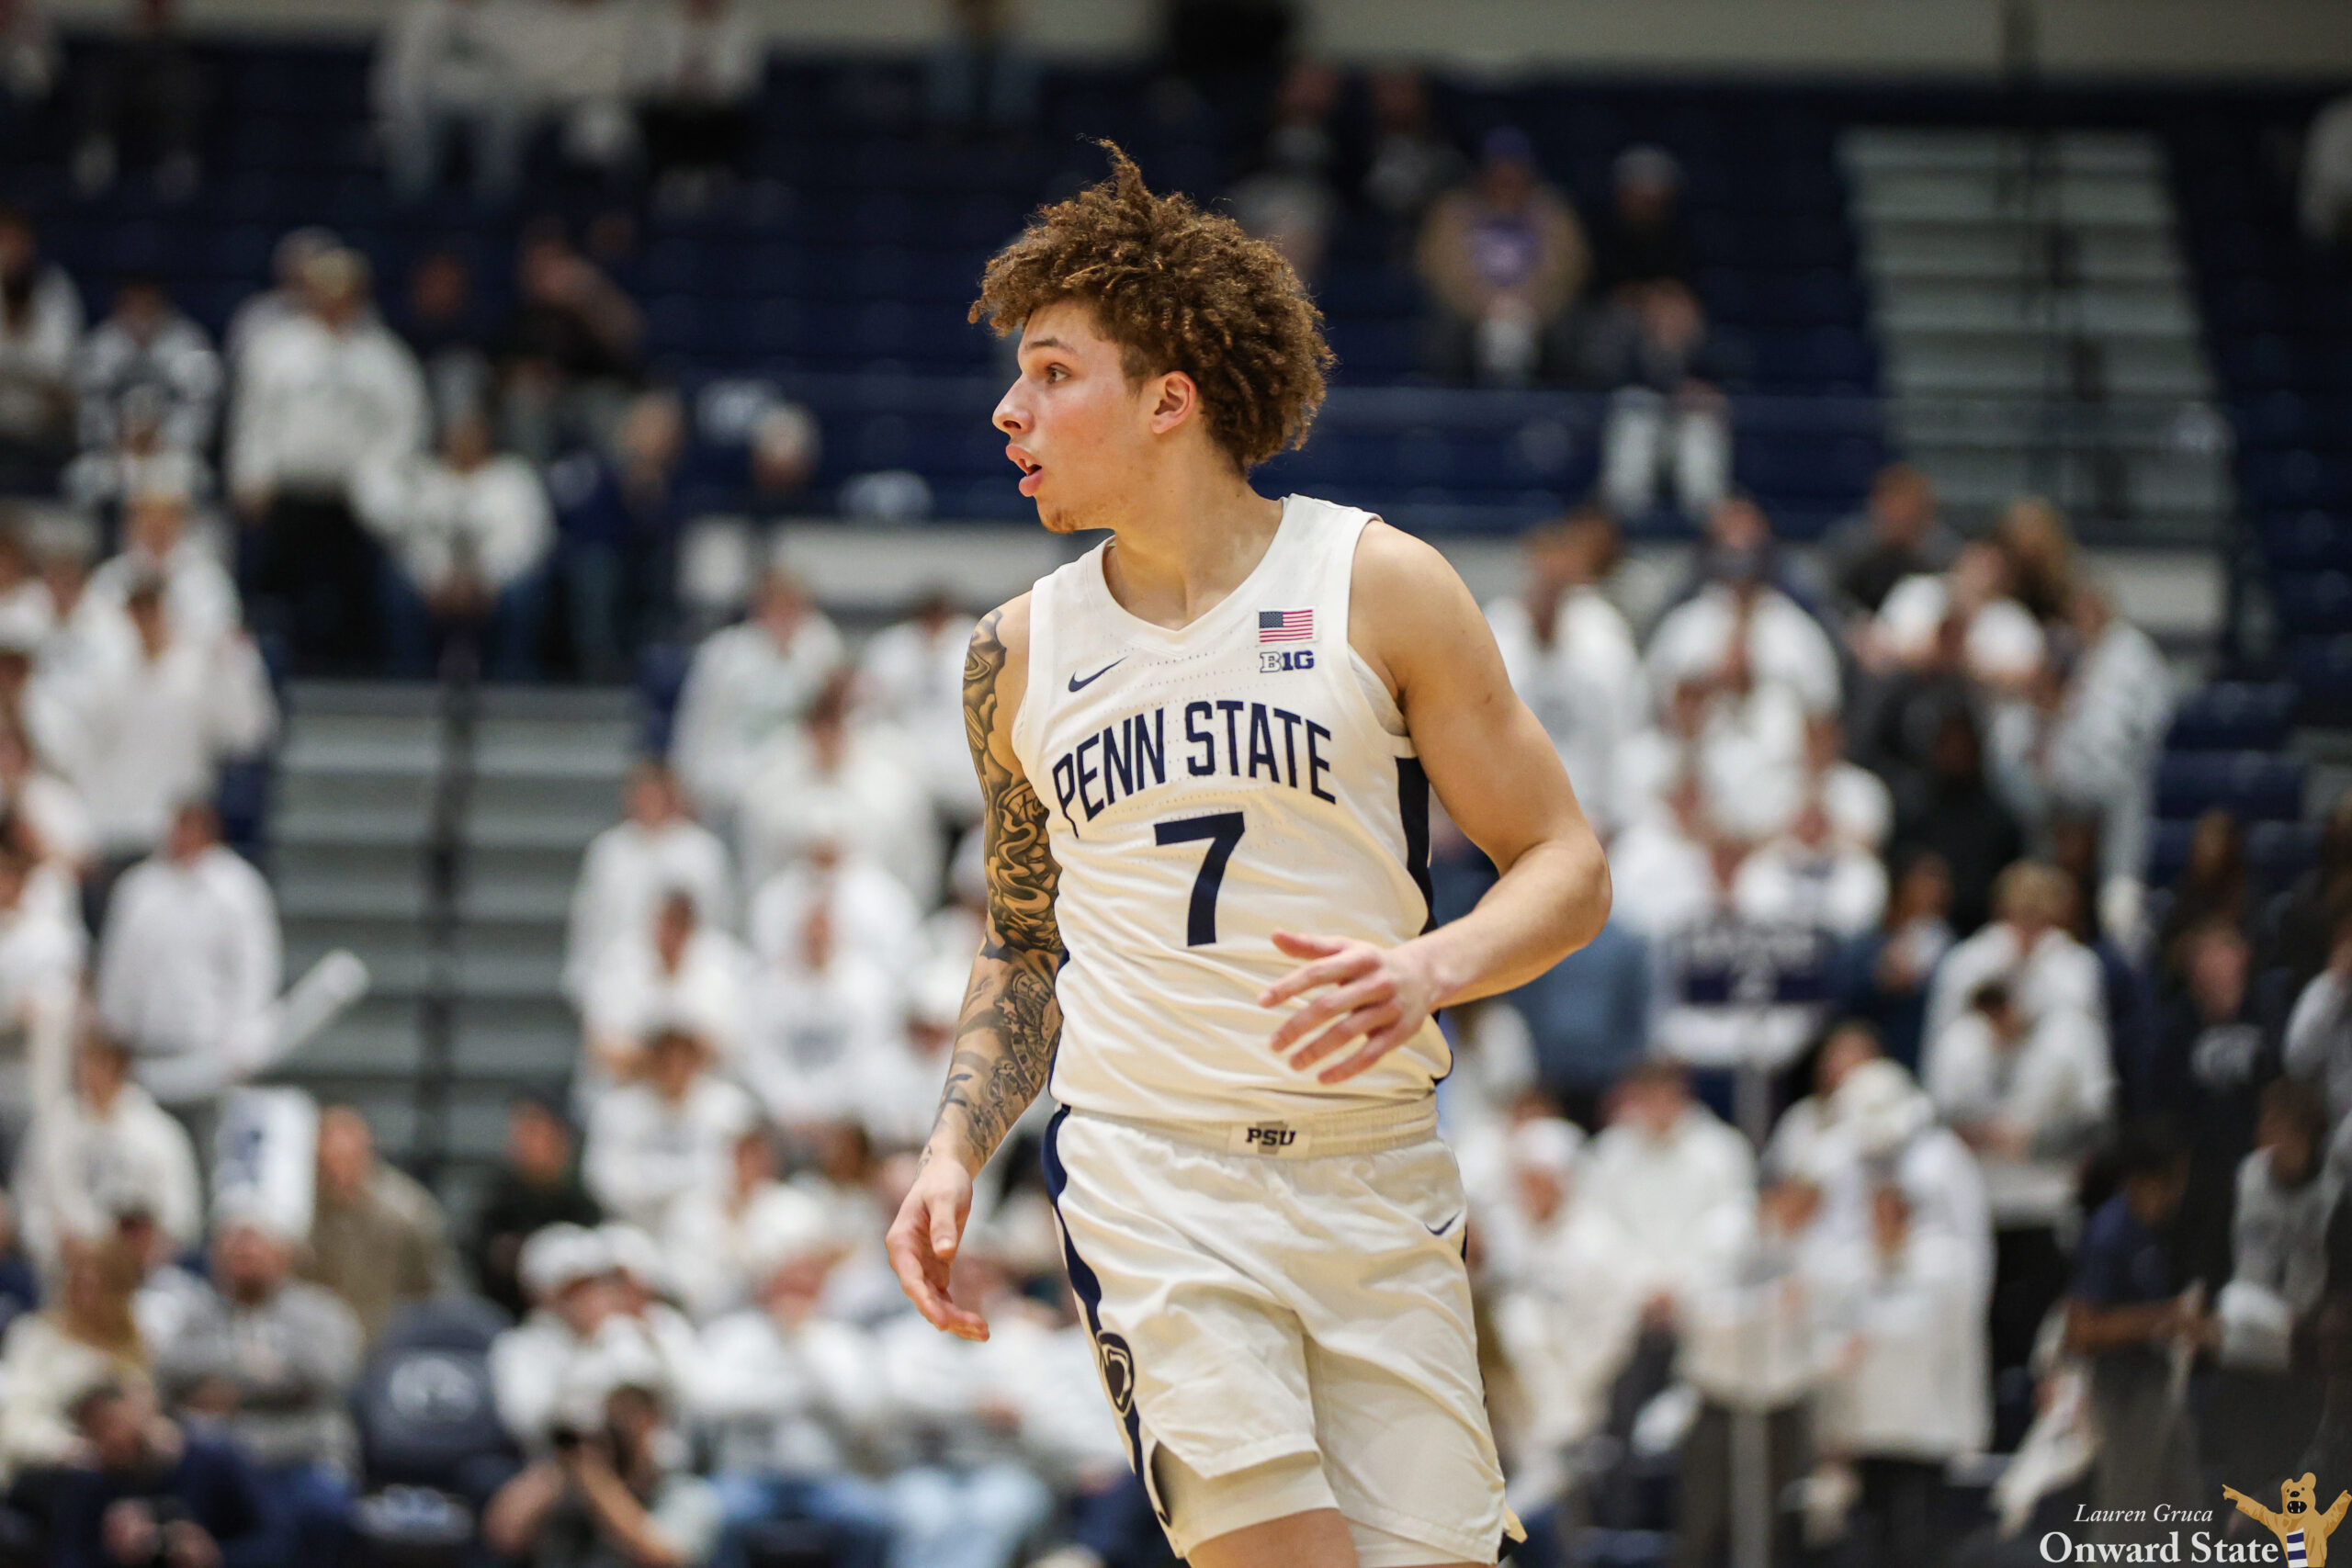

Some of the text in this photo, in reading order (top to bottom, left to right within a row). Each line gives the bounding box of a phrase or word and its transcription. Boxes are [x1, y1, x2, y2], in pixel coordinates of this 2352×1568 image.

[1052, 700, 1337, 839] PENN STATE
[1154, 811, 1246, 948] 7
[1246, 1126, 1297, 1146] PSU
